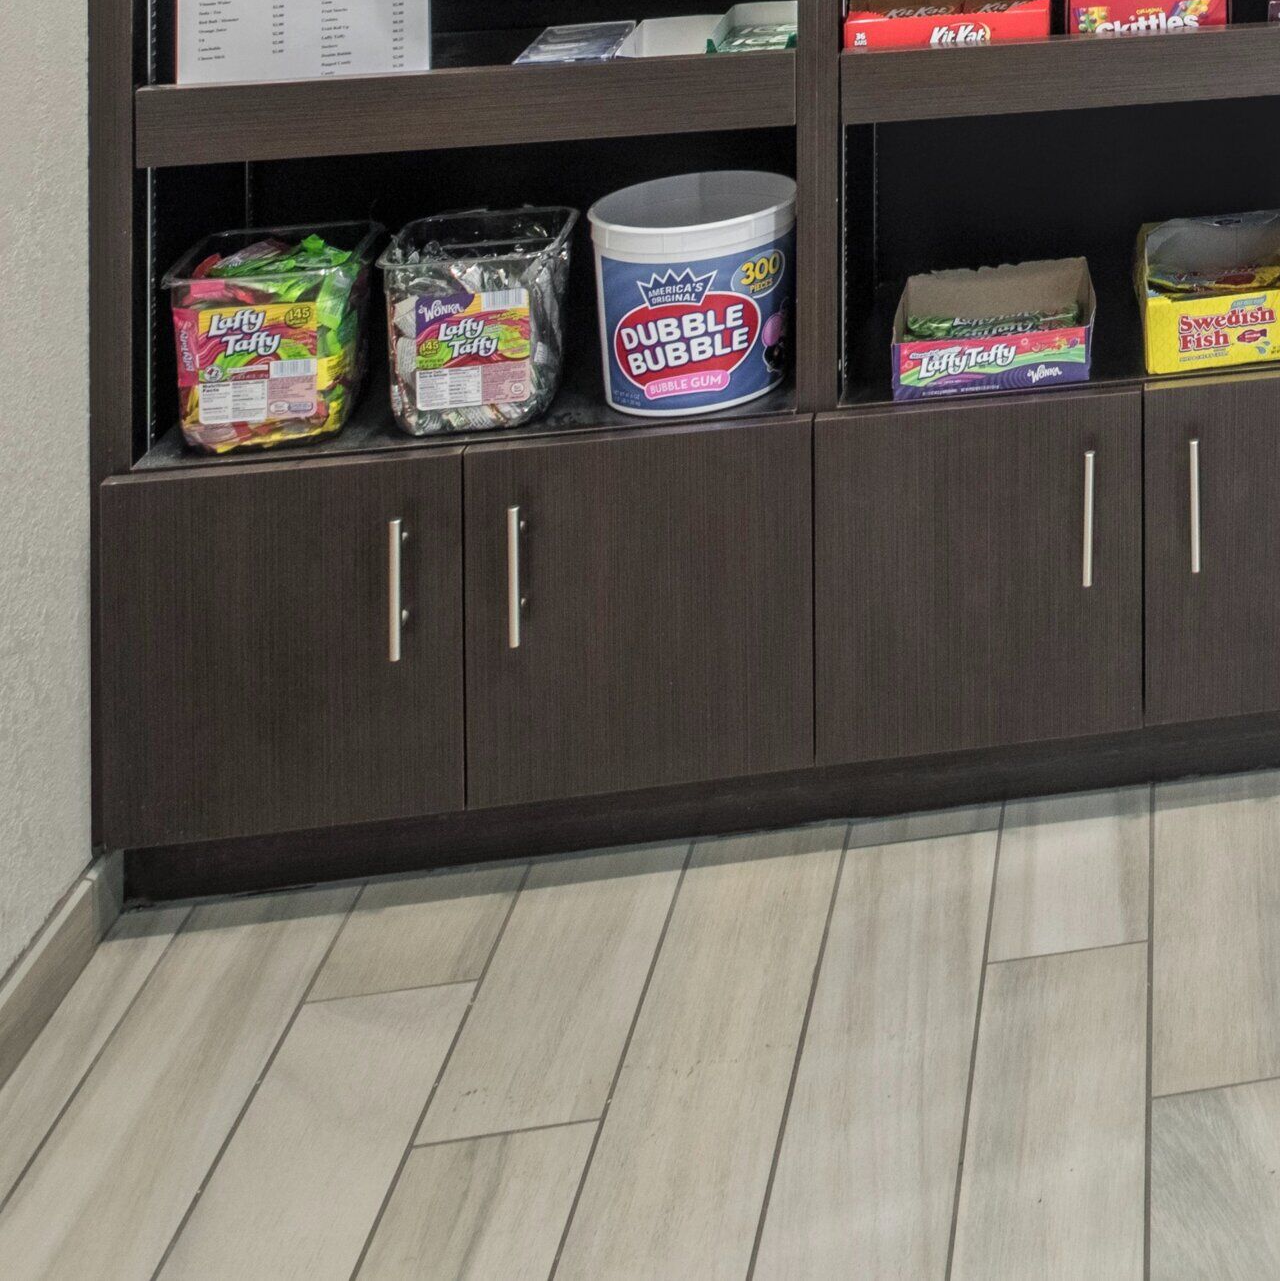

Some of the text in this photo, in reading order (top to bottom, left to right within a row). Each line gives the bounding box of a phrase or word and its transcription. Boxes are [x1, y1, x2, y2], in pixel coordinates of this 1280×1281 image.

[1095, 13, 1200, 33] Skittles
[855, 32, 866, 41] 36
[930, 25, 984, 43] Kit Kat
[740, 252, 781, 284] 300
[648, 282, 704, 298] AMERICA'S
[750, 278, 773, 293] PIECES
[651, 293, 698, 304] ORIGINAL
[423, 301, 464, 322] WONKA
[1178, 306, 1277, 334] Swedish
[207, 309, 263, 338] Laffy
[438, 318, 484, 340] Laffy
[620, 304, 744, 350] DUBBLE
[222, 331, 281, 356] Taffy
[449, 335, 499, 357] Taffy
[626, 326, 749, 377] BUBBLE
[1178, 330, 1231, 353] Fish
[650, 375, 722, 395] BUBBLE GUM
[1029, 365, 1063, 384] WONKA
